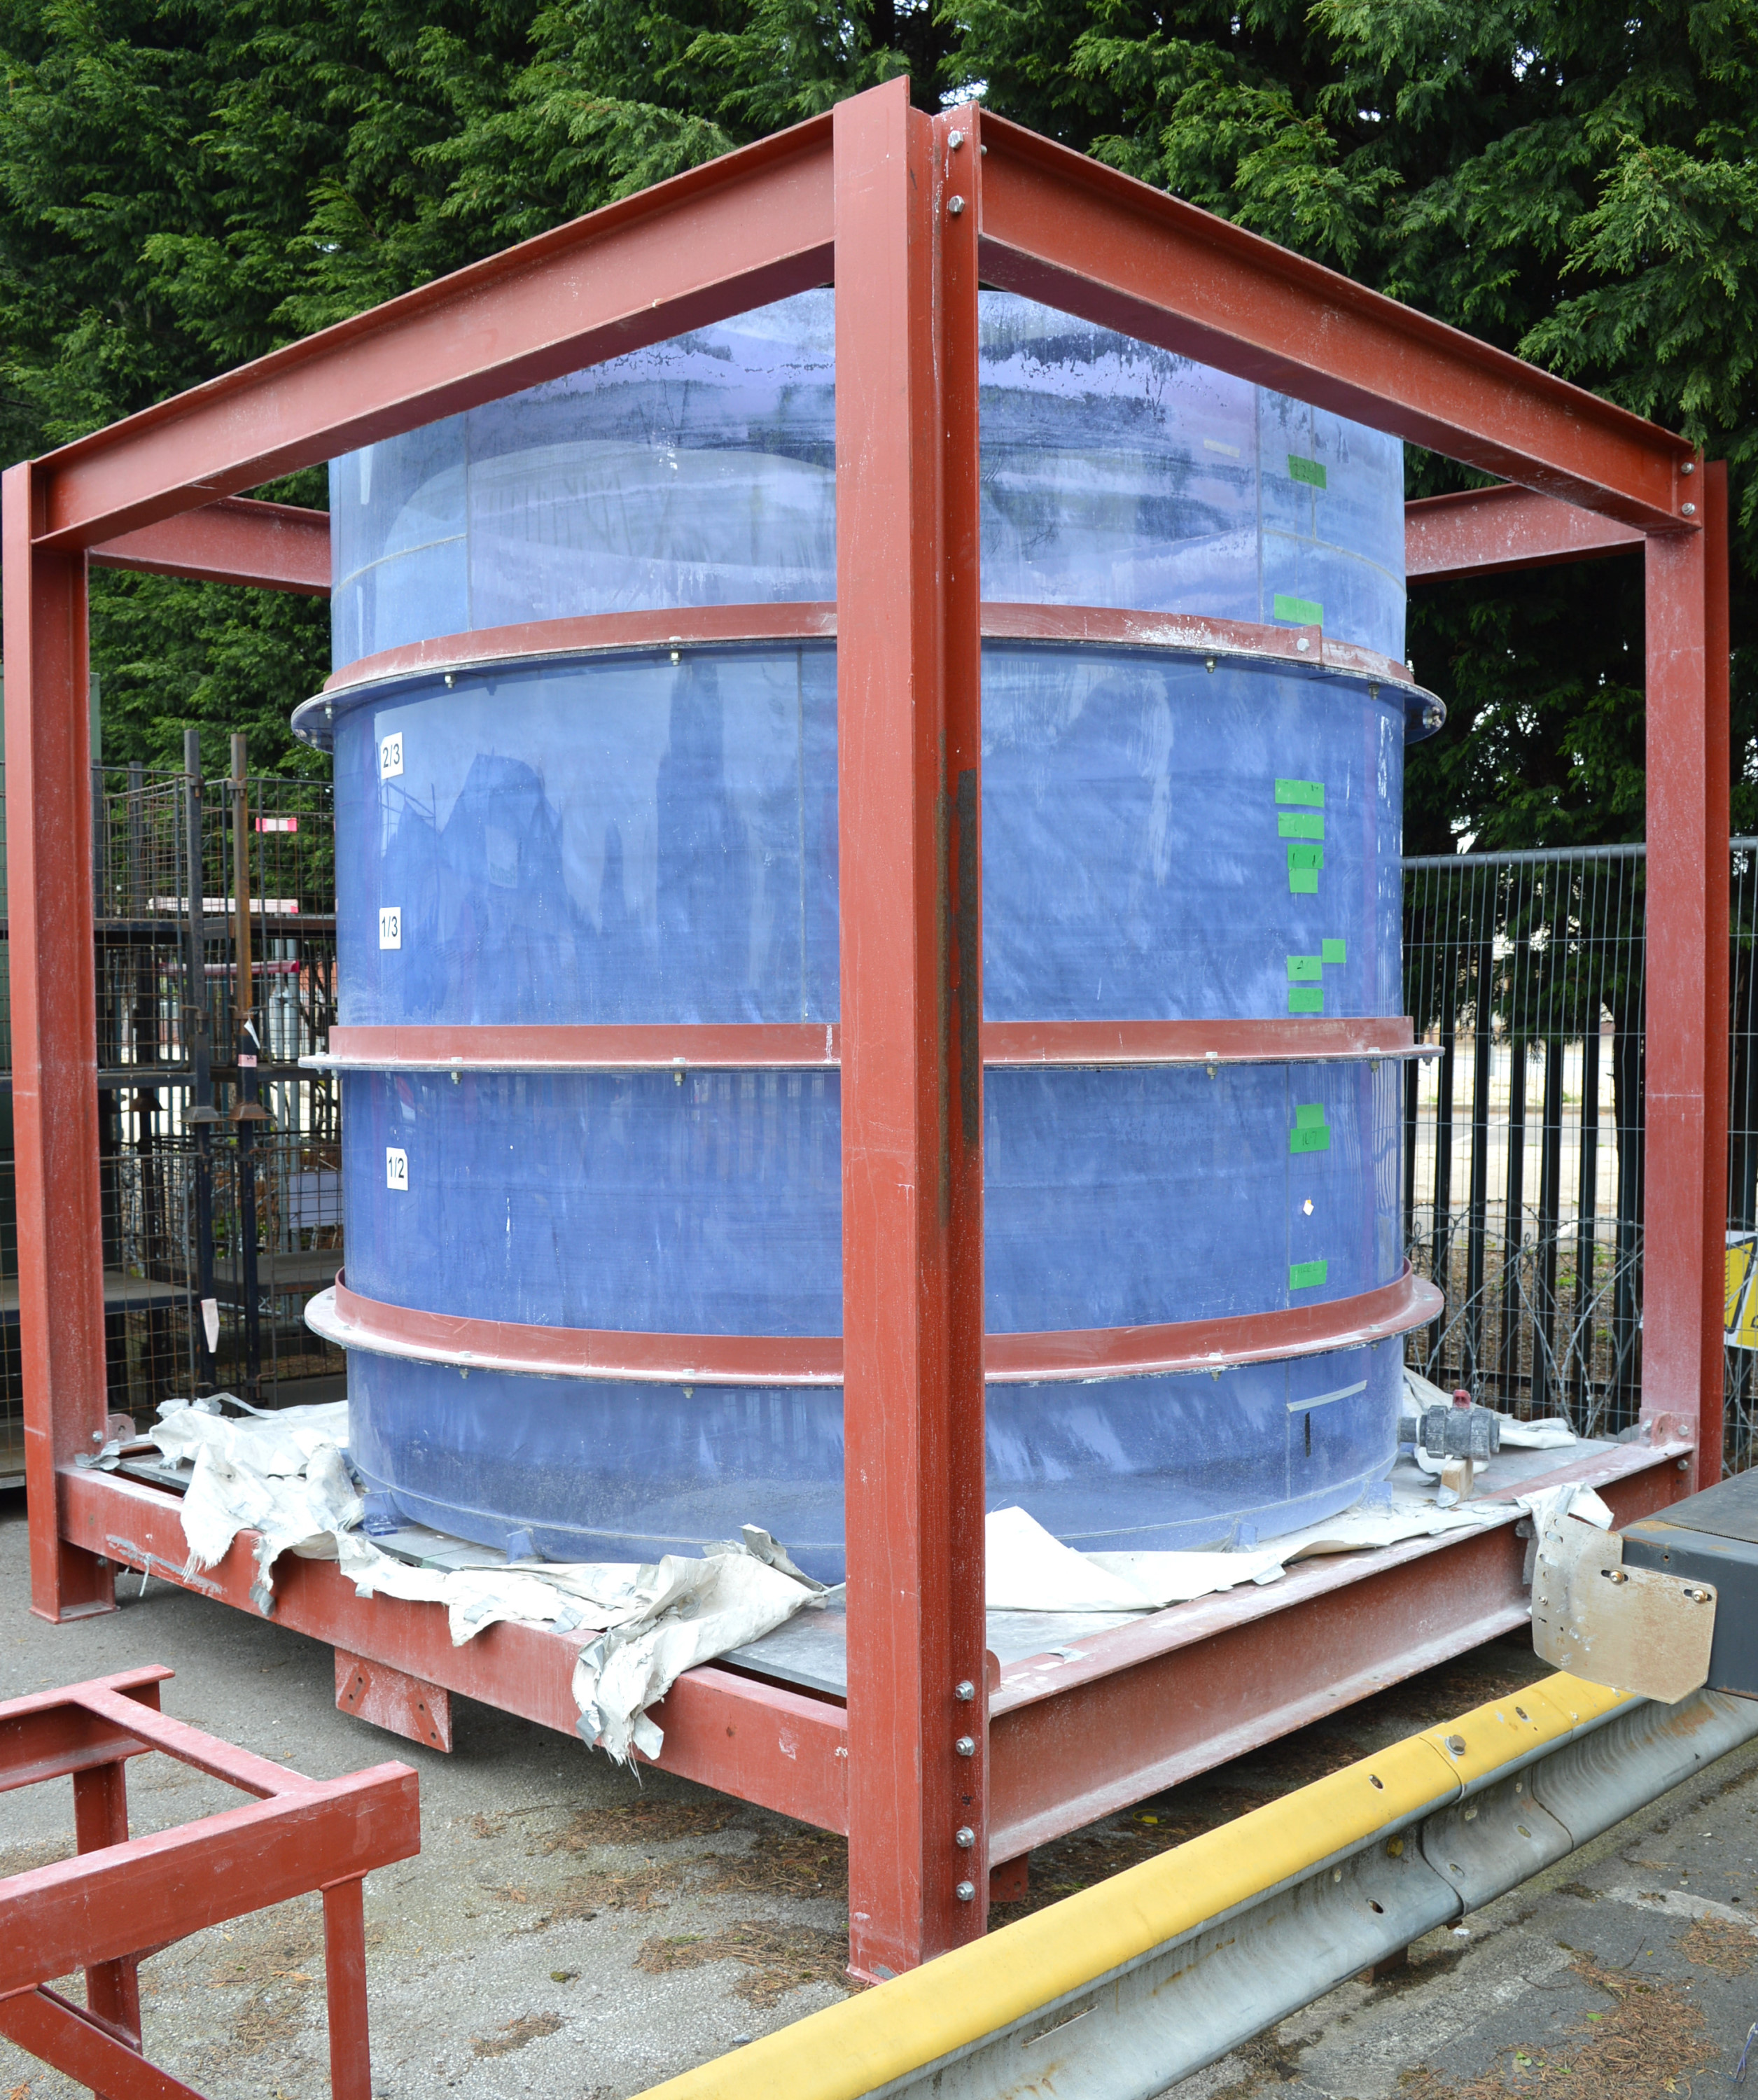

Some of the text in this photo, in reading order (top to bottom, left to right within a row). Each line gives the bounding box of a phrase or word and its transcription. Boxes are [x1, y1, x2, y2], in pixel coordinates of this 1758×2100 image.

[382, 743, 400, 769] 2/3
[382, 916, 398, 937] 1/3
[389, 1156, 405, 1179] 1/2
